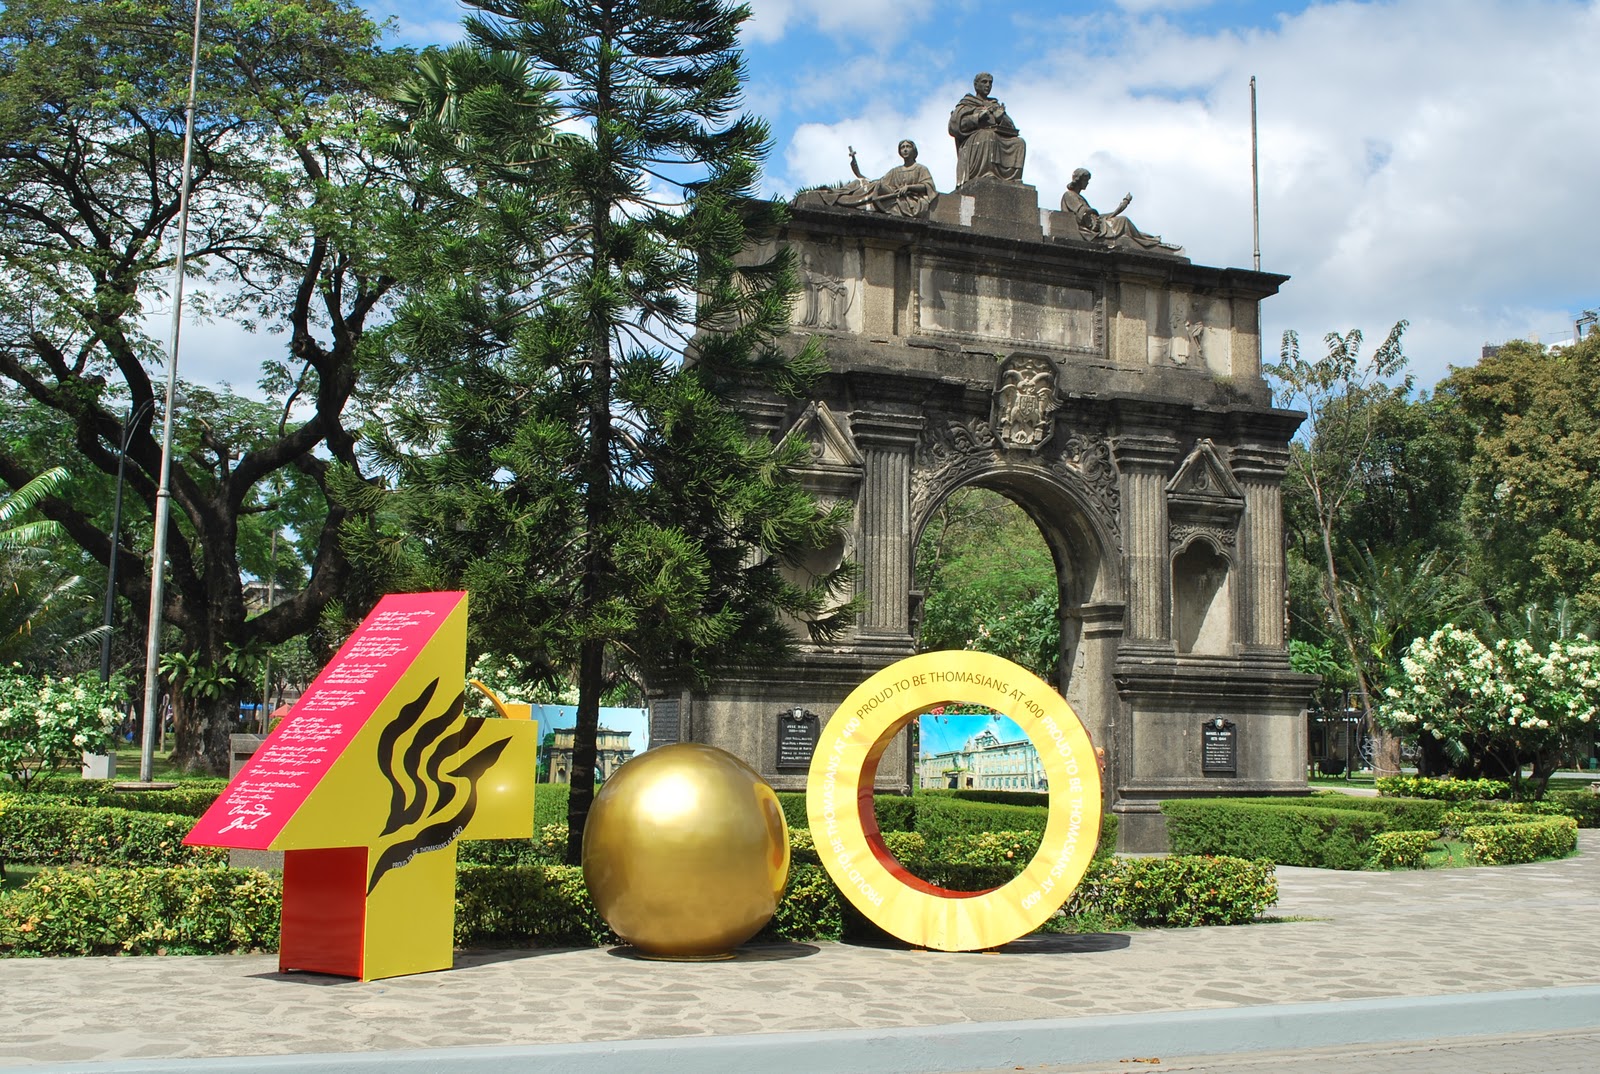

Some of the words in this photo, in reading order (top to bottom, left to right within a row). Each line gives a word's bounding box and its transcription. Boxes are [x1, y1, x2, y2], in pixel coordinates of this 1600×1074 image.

[856, 687, 894, 720] PROUD
[893, 679, 911, 693] TO
[912, 674, 927, 687] BE
[928, 671, 1010, 694] THOMASIANS
[1009, 688, 1026, 702] AT
[1024, 699, 1045, 719] 400
[841, 716, 861, 739] 400
[1041, 715, 1073, 758] PROUD
[834, 737, 847, 754] AT
[1064, 758, 1079, 776] TO
[823, 754, 841, 836] THOMASIANS
[1069, 777, 1082, 793] BE
[830, 836, 845, 853] BE
[1051, 796, 1083, 878] THOMASIANS
[392, 860, 408, 868] PROUD
[837, 852, 852, 872] TO
[849, 867, 886, 907] PROUD
[1040, 876, 1056, 895] AT
[1021, 889, 1042, 911] 400
